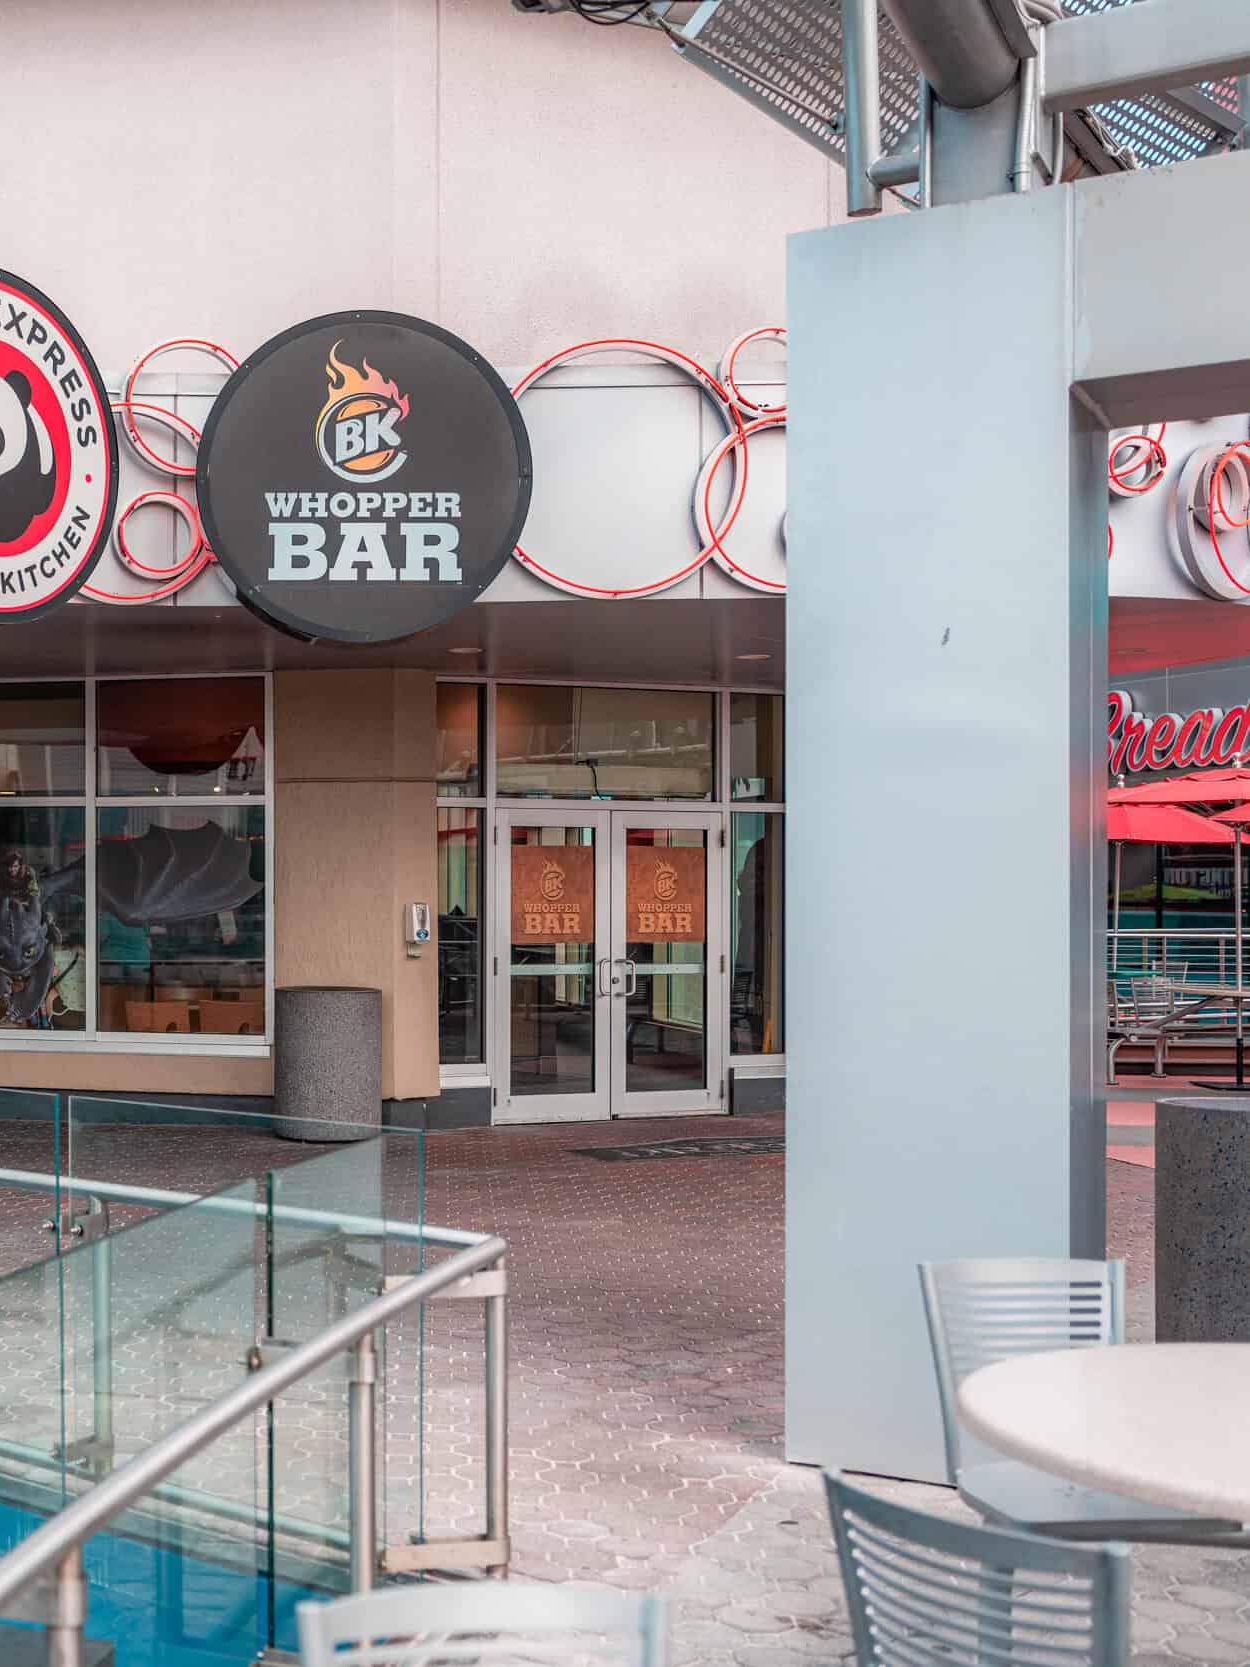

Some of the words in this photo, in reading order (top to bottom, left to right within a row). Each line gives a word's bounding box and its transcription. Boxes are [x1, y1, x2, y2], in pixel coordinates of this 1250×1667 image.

[335, 407, 401, 464] BK
[264, 492, 462, 518] WHOPPER
[1, 505, 91, 594] KITCHEN
[268, 522, 463, 584] BAR
[544, 876, 563, 893] BK
[658, 876, 676, 893] BK
[524, 903, 580, 913] WHOPPER
[638, 903, 692, 913] WHOPPER
[524, 914, 581, 934] BAR
[638, 914, 692, 933] BAR
